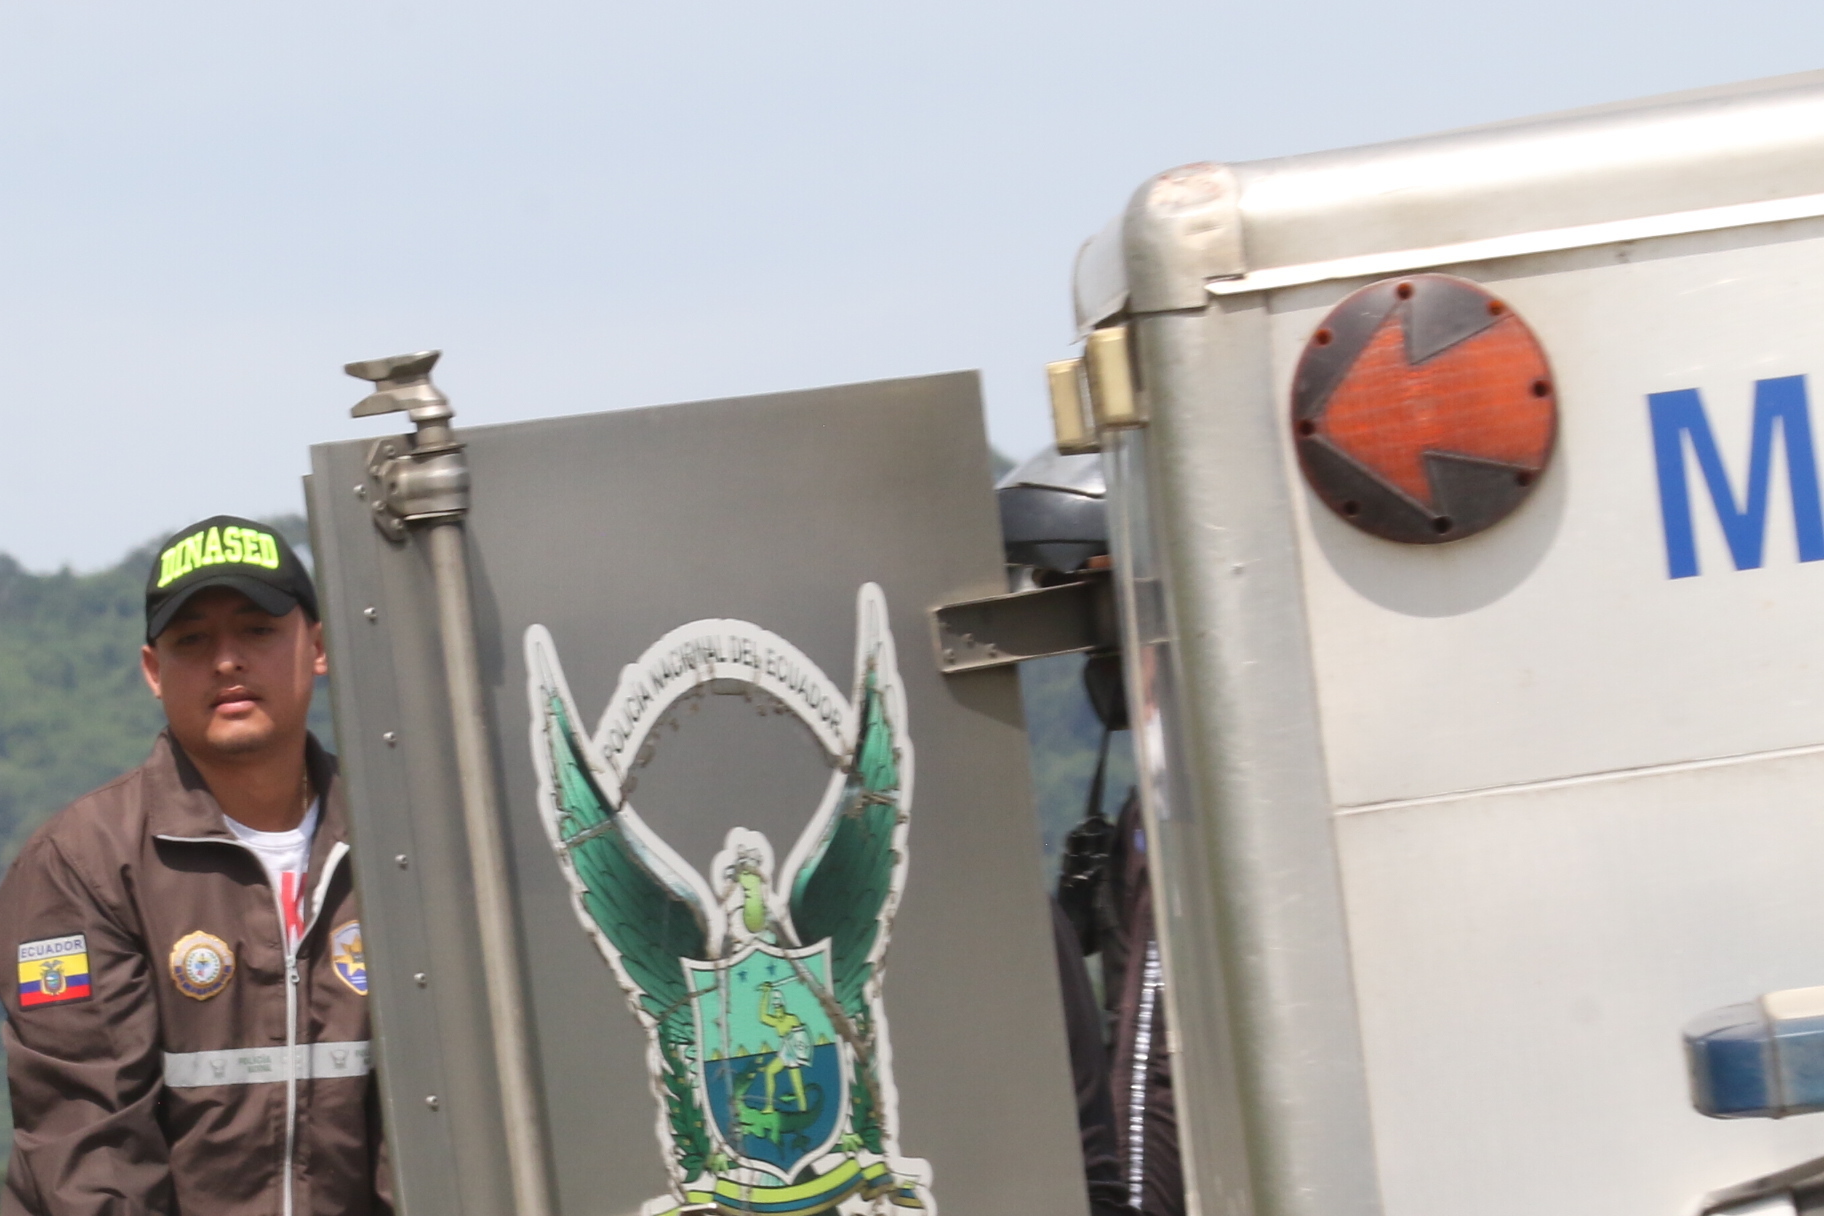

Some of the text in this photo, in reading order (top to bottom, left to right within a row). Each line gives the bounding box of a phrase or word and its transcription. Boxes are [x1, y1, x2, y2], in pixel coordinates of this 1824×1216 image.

[1647, 373, 1824, 580] M
[157, 526, 279, 588] DINASED
[766, 648, 843, 738] ECUADOR
[21, 939, 83, 958] ECUADOR
